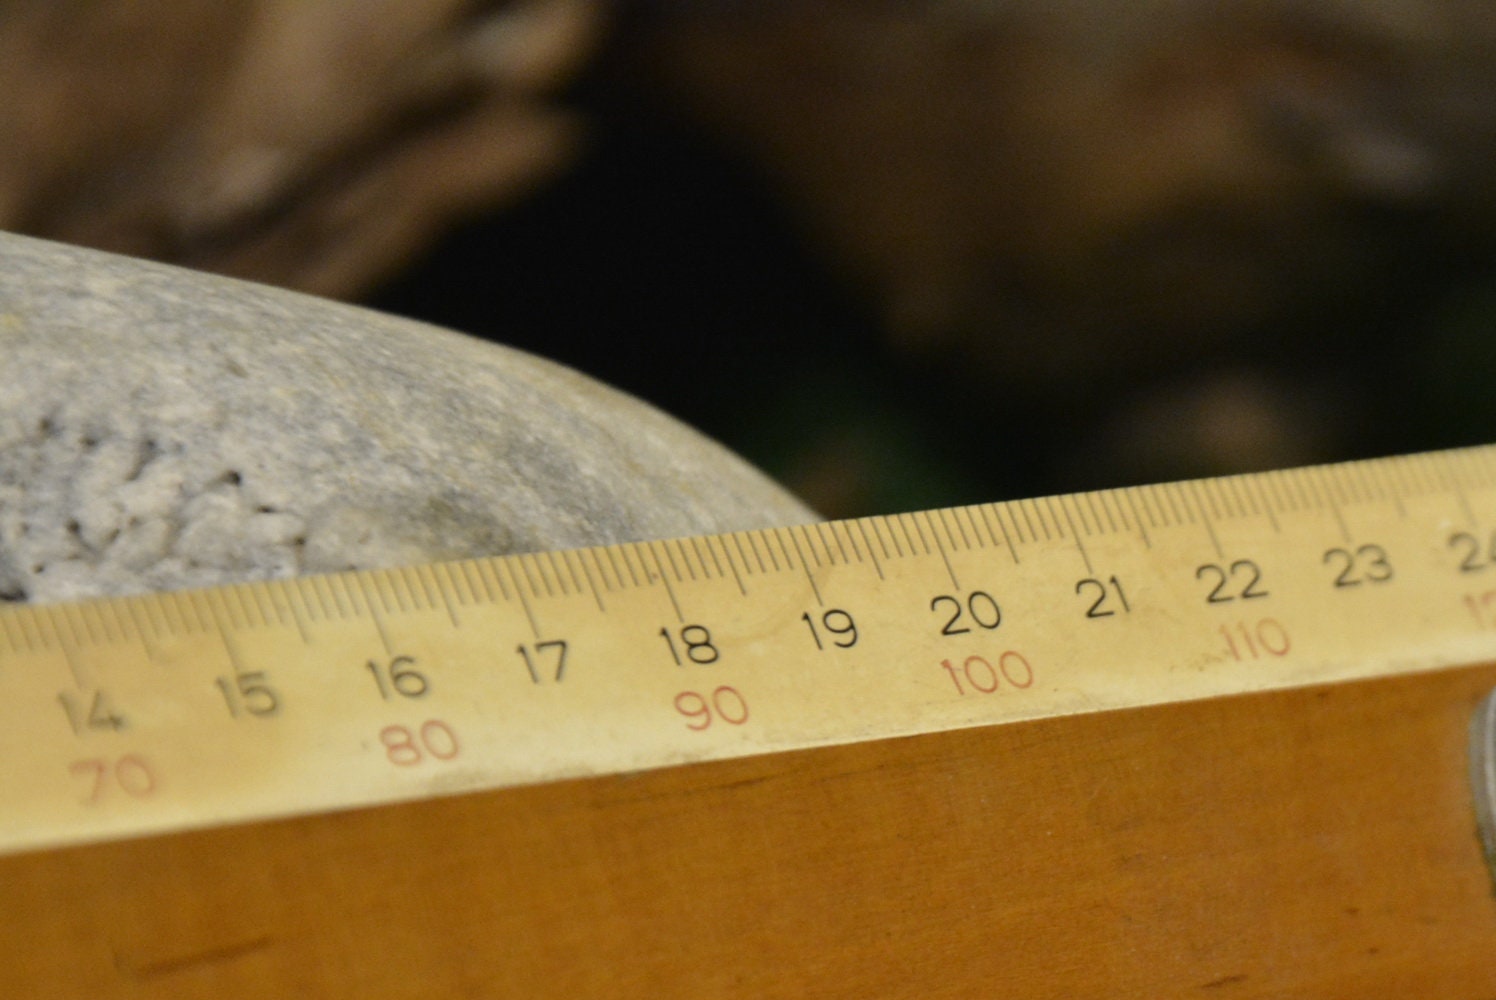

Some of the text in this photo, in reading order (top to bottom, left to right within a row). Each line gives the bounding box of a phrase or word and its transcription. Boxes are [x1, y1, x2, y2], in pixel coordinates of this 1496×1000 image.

[57, 688, 128, 736] 14
[215, 672, 280, 718] 15
[366, 656, 429, 700] 16
[516, 640, 568, 684] 17
[660, 625, 720, 666] 18
[802, 608, 859, 650] 19
[930, 591, 1002, 636] 20
[1075, 575, 1133, 619] 21
[1196, 559, 1269, 604] 22
[1323, 543, 1395, 588] 23
[68, 752, 157, 806] 70
[380, 720, 460, 768] 80
[673, 685, 750, 732] 90
[941, 650, 1034, 695] 100
[1220, 617, 1292, 663] 110
